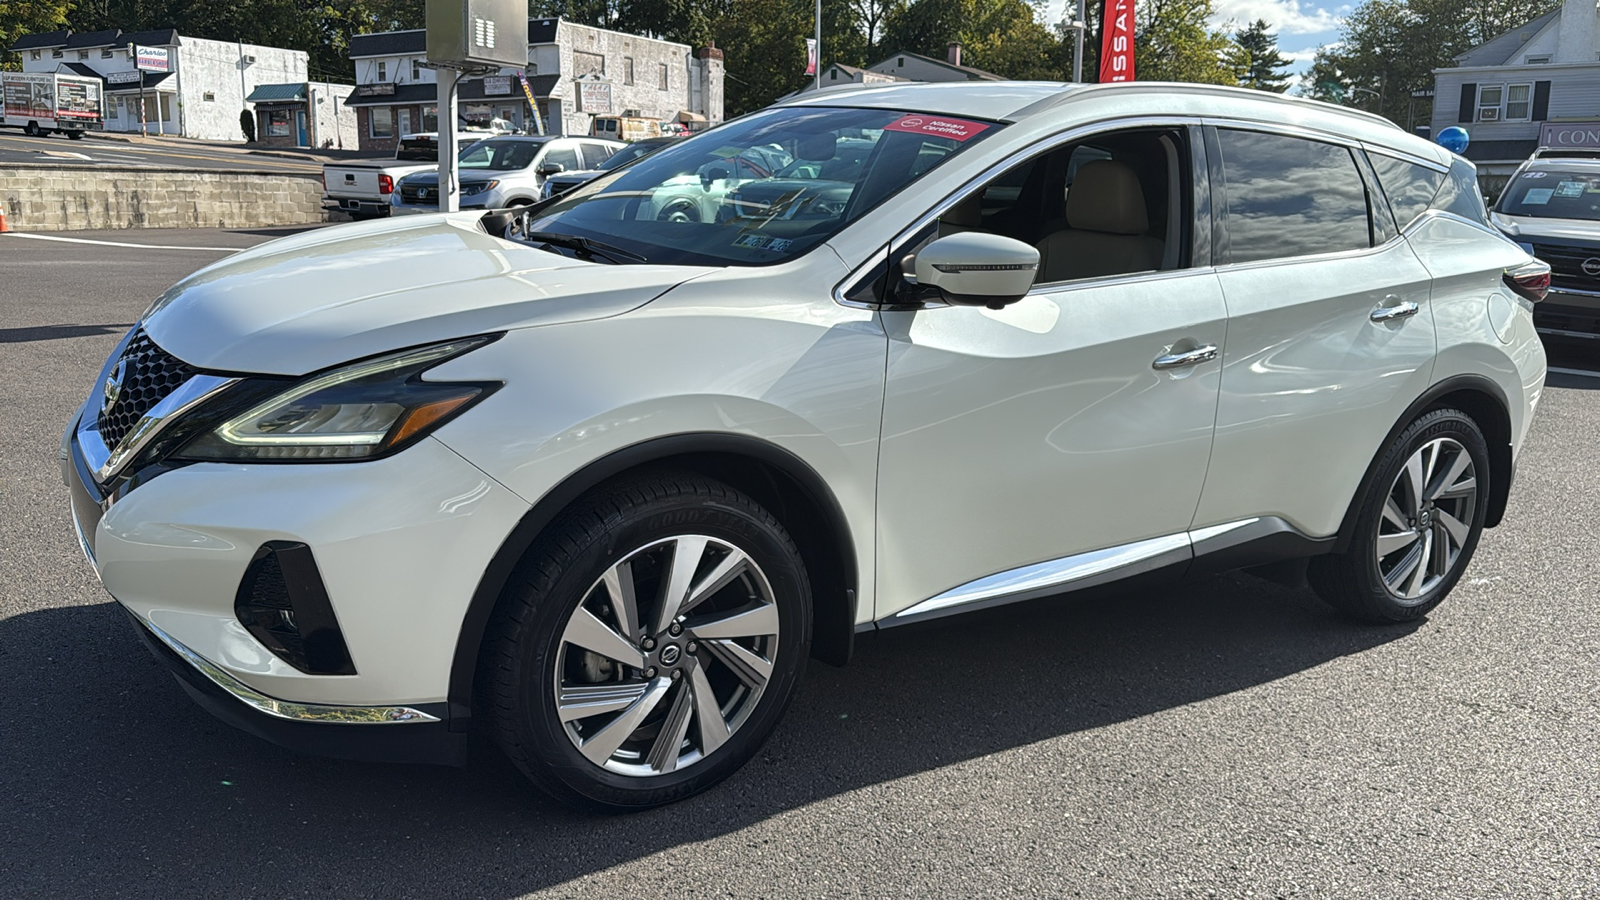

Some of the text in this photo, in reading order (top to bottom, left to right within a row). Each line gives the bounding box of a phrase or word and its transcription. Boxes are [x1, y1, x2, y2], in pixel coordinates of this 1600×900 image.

[1112, 0, 1127, 82] ISSAN
[922, 125, 968, 136] Certified
[929, 120, 965, 130] Nissan
